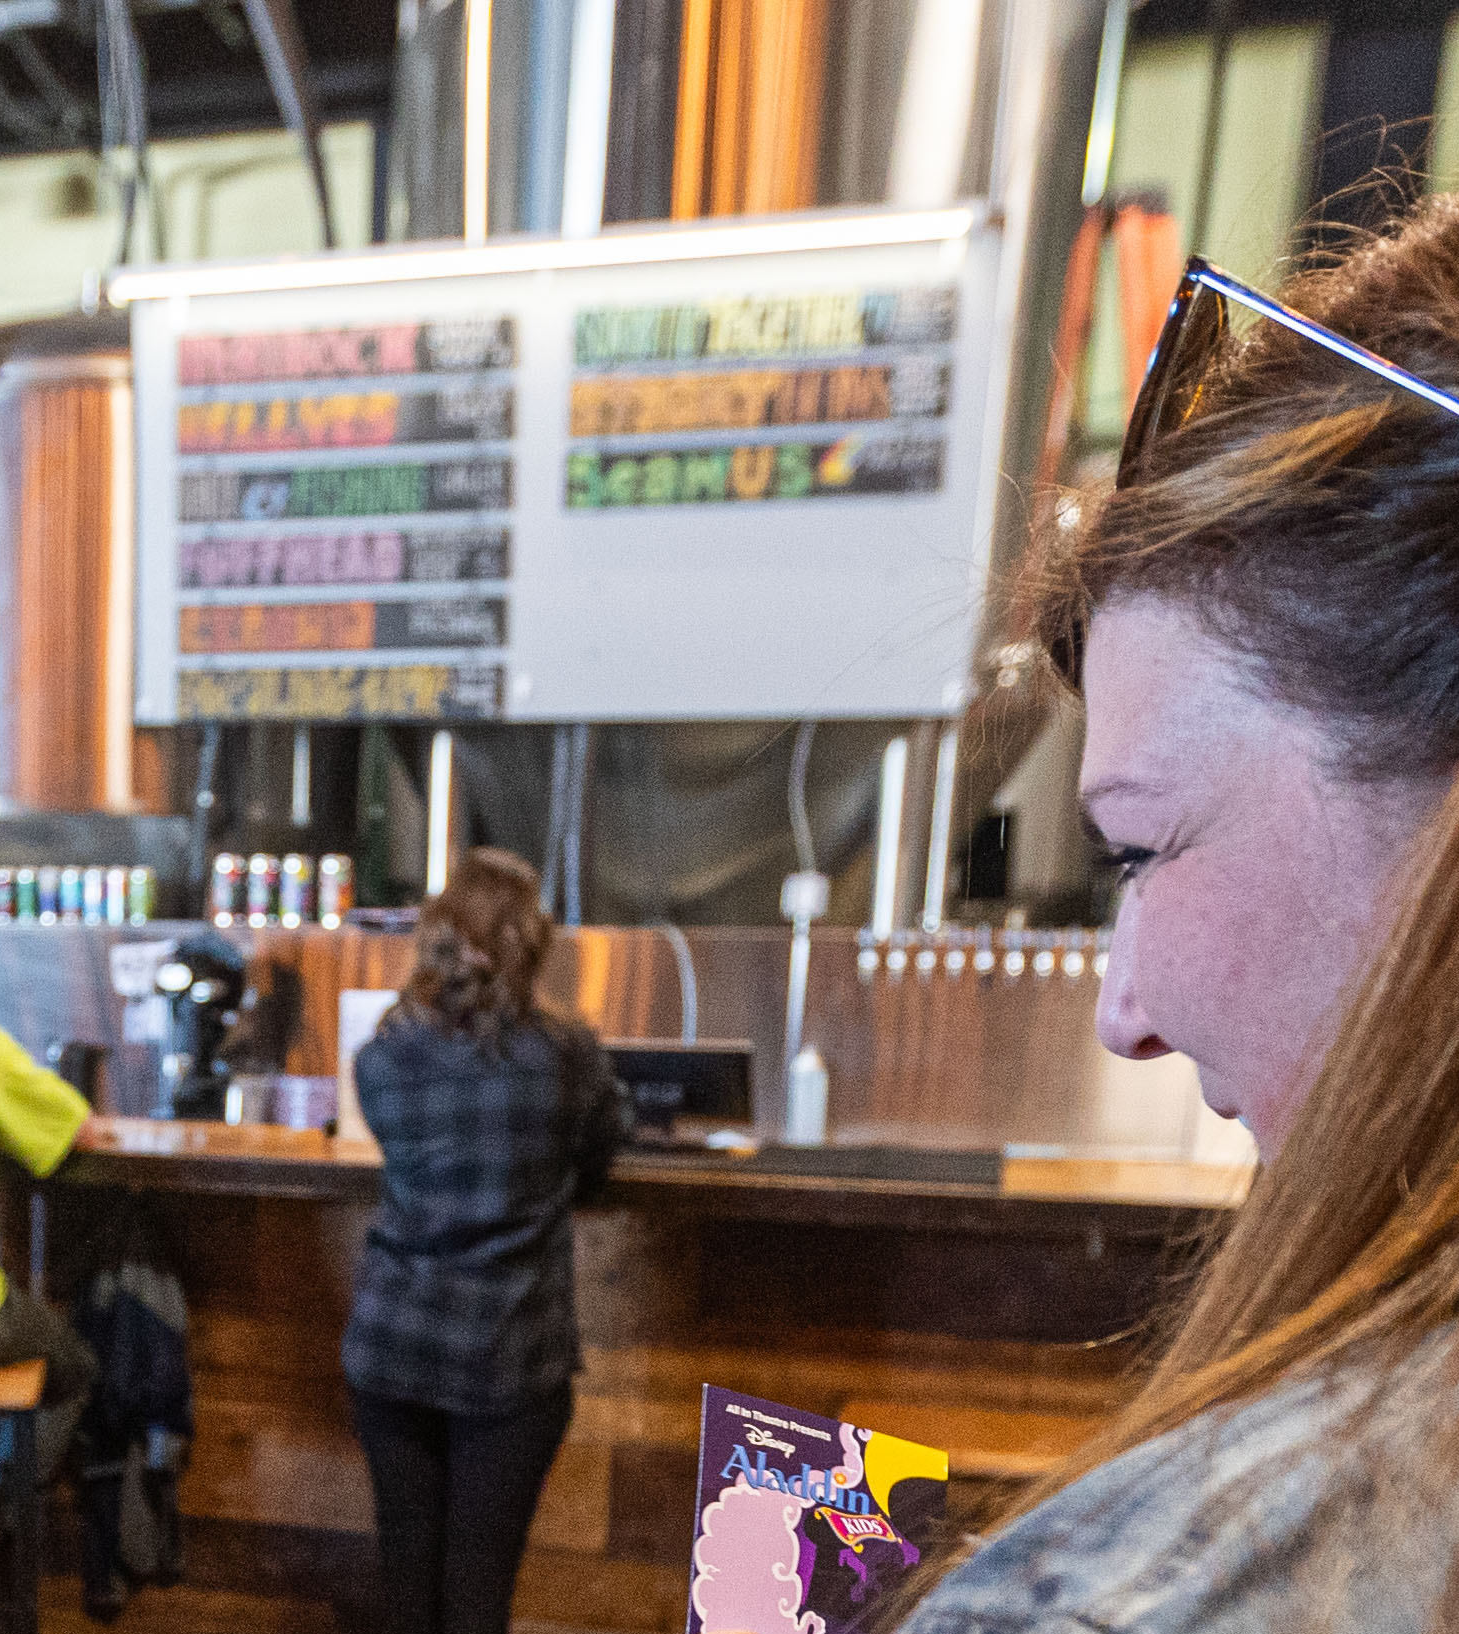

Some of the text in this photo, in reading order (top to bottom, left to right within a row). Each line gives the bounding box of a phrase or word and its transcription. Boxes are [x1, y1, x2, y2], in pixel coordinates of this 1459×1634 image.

[742, 1423, 797, 1459] Disney
[789, 1421, 832, 1442] Presents
[720, 1444, 871, 1515] Aladdin
[840, 1516, 884, 1535] KIDS
